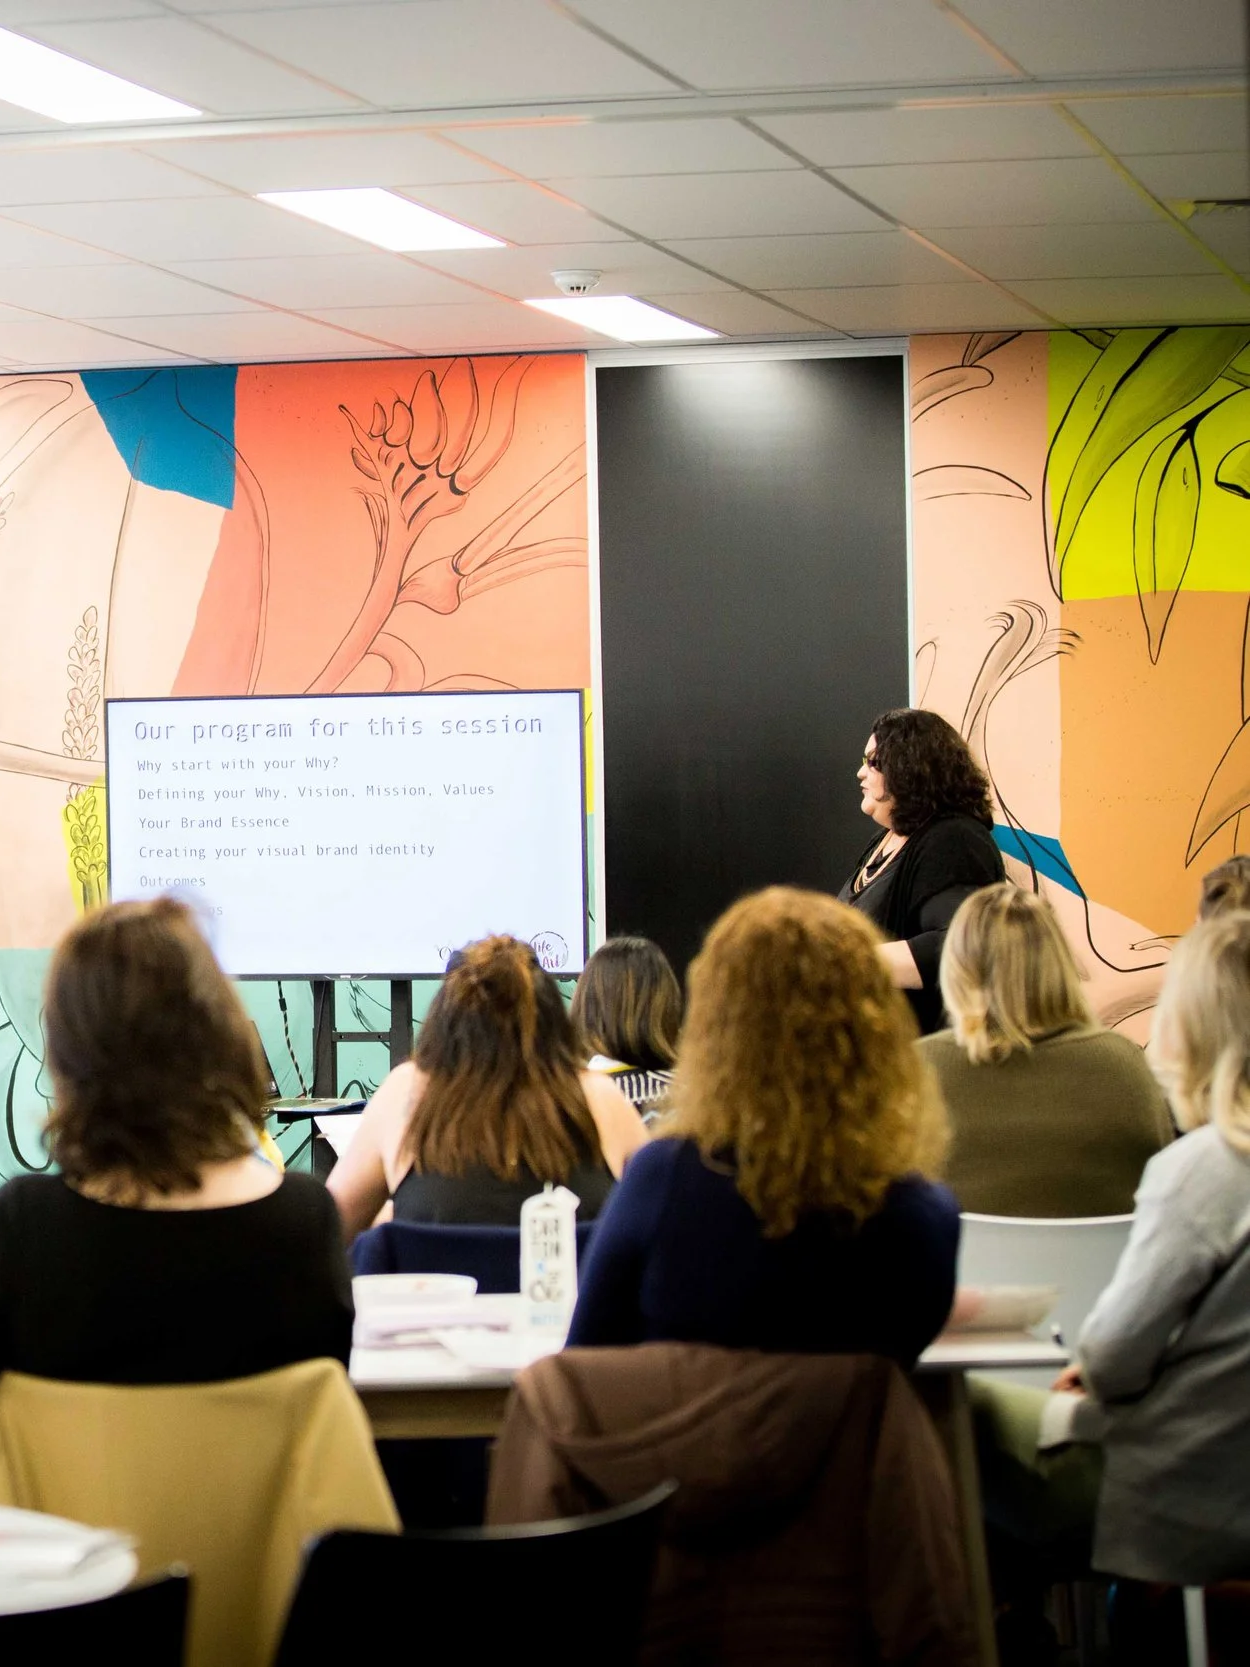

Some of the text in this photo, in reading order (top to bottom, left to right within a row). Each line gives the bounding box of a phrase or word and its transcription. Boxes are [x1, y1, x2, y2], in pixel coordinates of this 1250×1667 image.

[135, 714, 543, 744] Our program for this session
[137, 756, 339, 774] Why start with your Why?
[138, 787, 205, 801] Defining
[213, 788, 246, 802] your
[442, 783, 495, 796] Values
[139, 816, 289, 829] Your Brand Essence
[139, 843, 435, 860] Creating your visual brand identity
[140, 875, 206, 888] Outcomes
